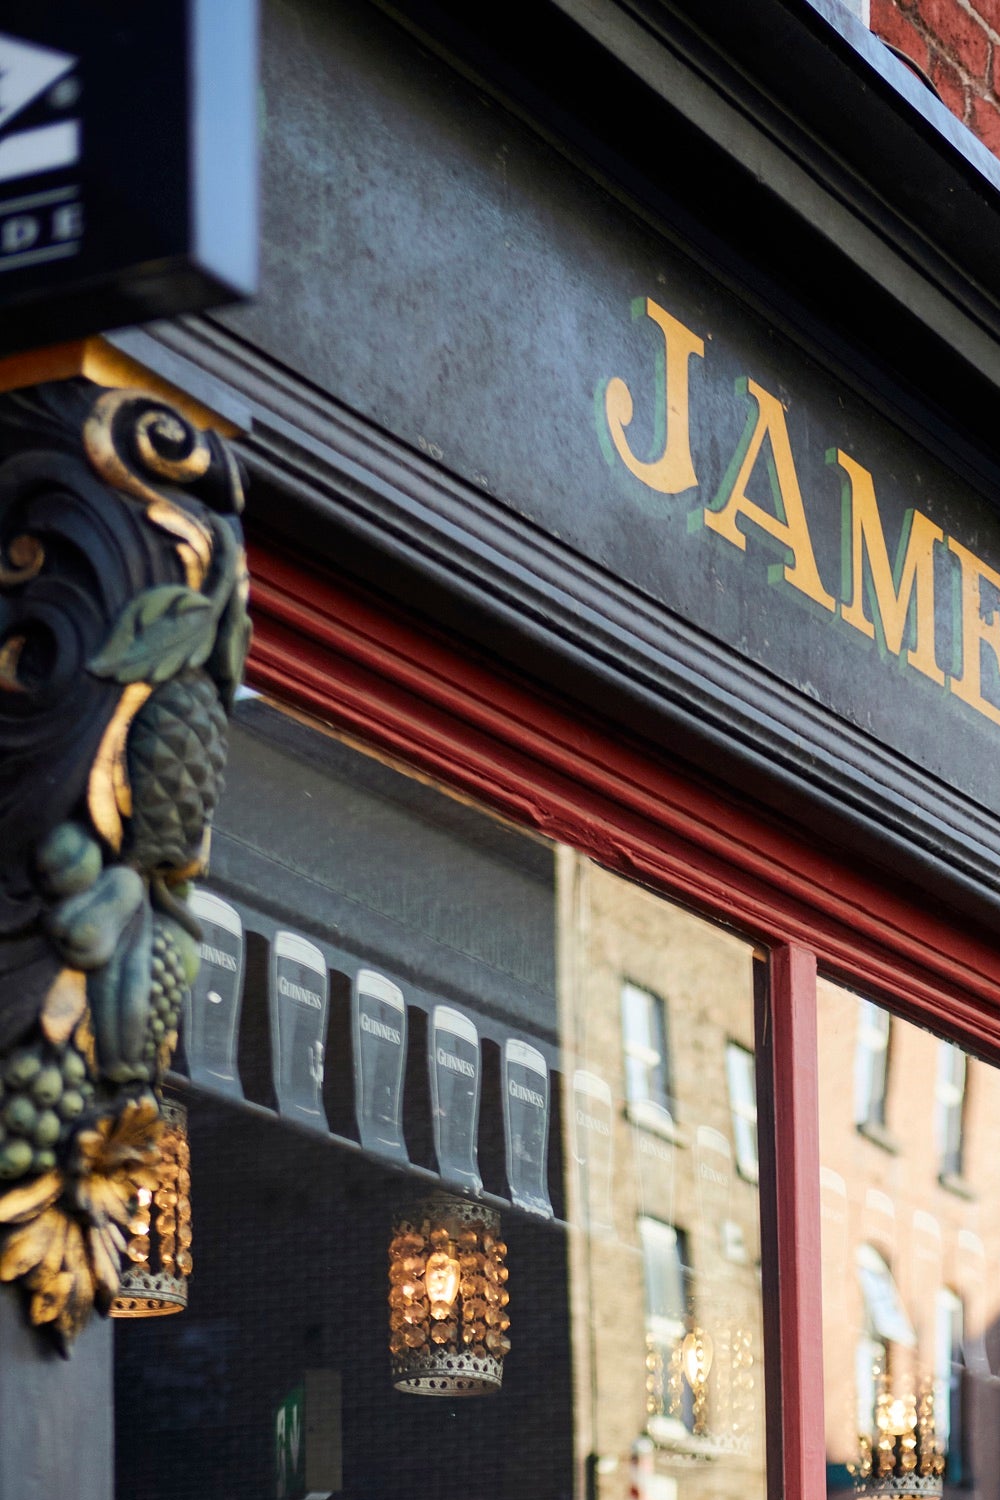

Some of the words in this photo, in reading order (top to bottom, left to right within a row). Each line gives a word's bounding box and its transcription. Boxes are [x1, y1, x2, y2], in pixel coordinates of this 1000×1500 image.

[201, 943, 237, 973] UINNESS
[279, 976, 322, 1010] GUINNESS
[360, 1012, 401, 1046] GUINNESS
[437, 1047, 475, 1079] GUINNESS
[509, 1079, 545, 1109] GUINNESS
